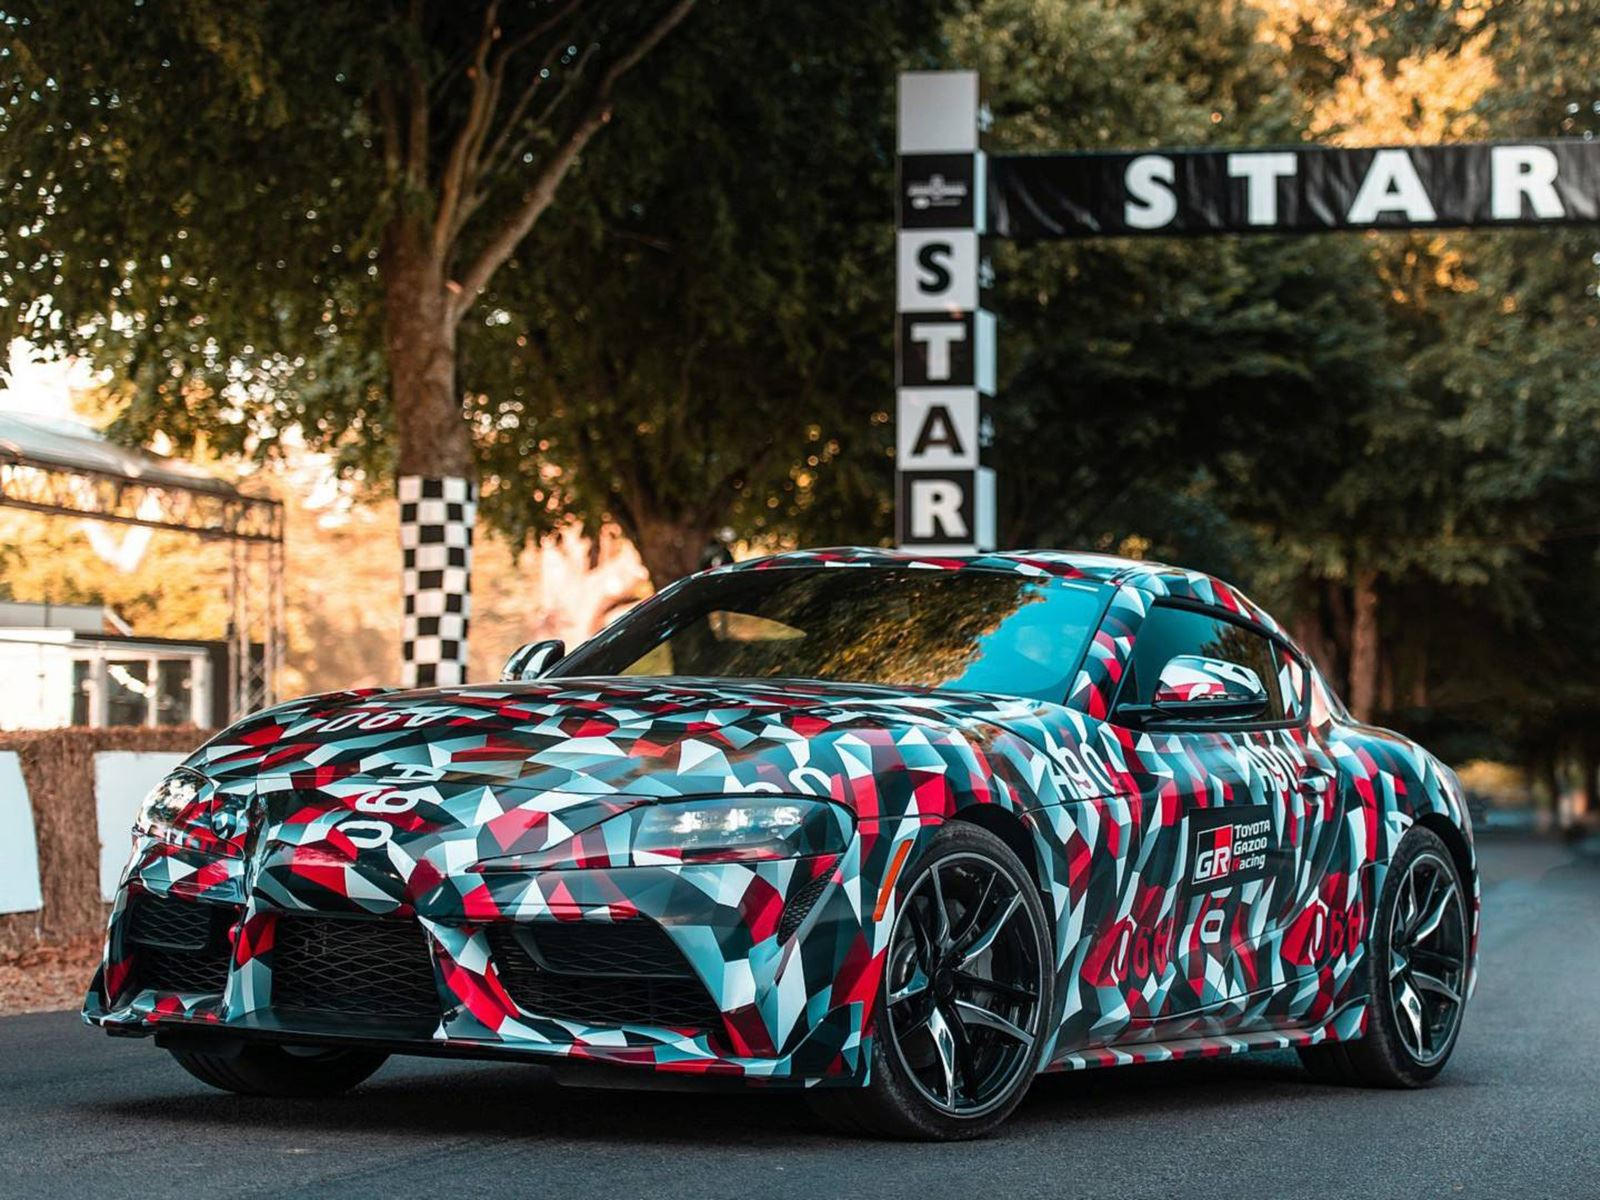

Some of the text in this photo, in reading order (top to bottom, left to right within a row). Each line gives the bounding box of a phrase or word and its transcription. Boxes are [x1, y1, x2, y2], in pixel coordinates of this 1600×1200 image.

[1124, 145, 1565, 229] STAR
[910, 243, 967, 537] STAR
[1045, 742, 1116, 800] A90
[1196, 846, 1231, 879] GR
[1232, 854, 1266, 872] Racing
